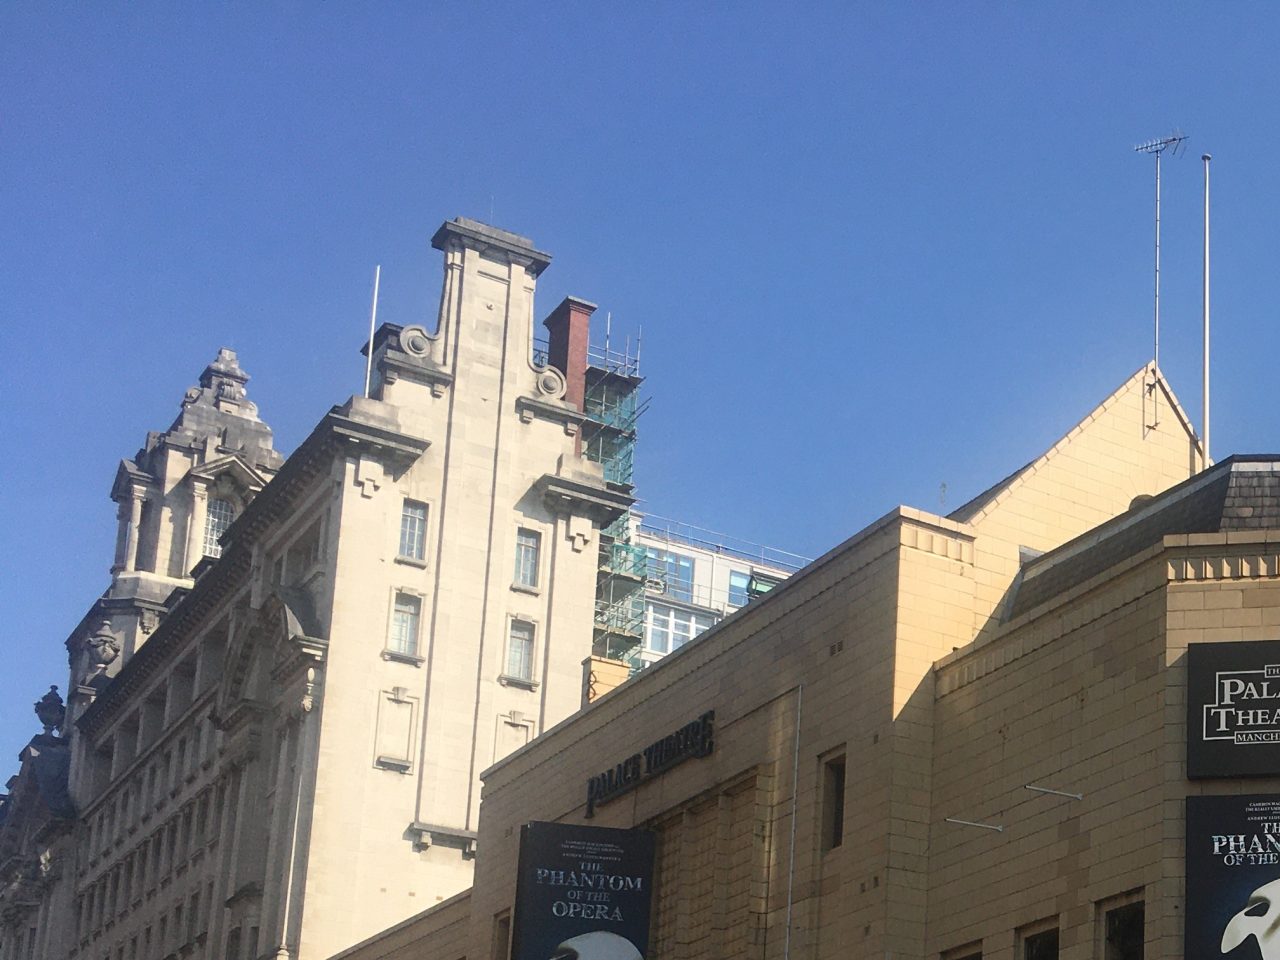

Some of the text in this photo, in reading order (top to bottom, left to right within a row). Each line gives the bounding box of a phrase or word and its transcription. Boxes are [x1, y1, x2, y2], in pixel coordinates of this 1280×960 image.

[1223, 854, 1244, 866] OF
[1247, 852, 1278, 865] THE
[580, 861, 604, 872] THE
[536, 868, 643, 892] PHANTOM
[567, 890, 611, 903] OF THE
[552, 901, 624, 922] OPERA
